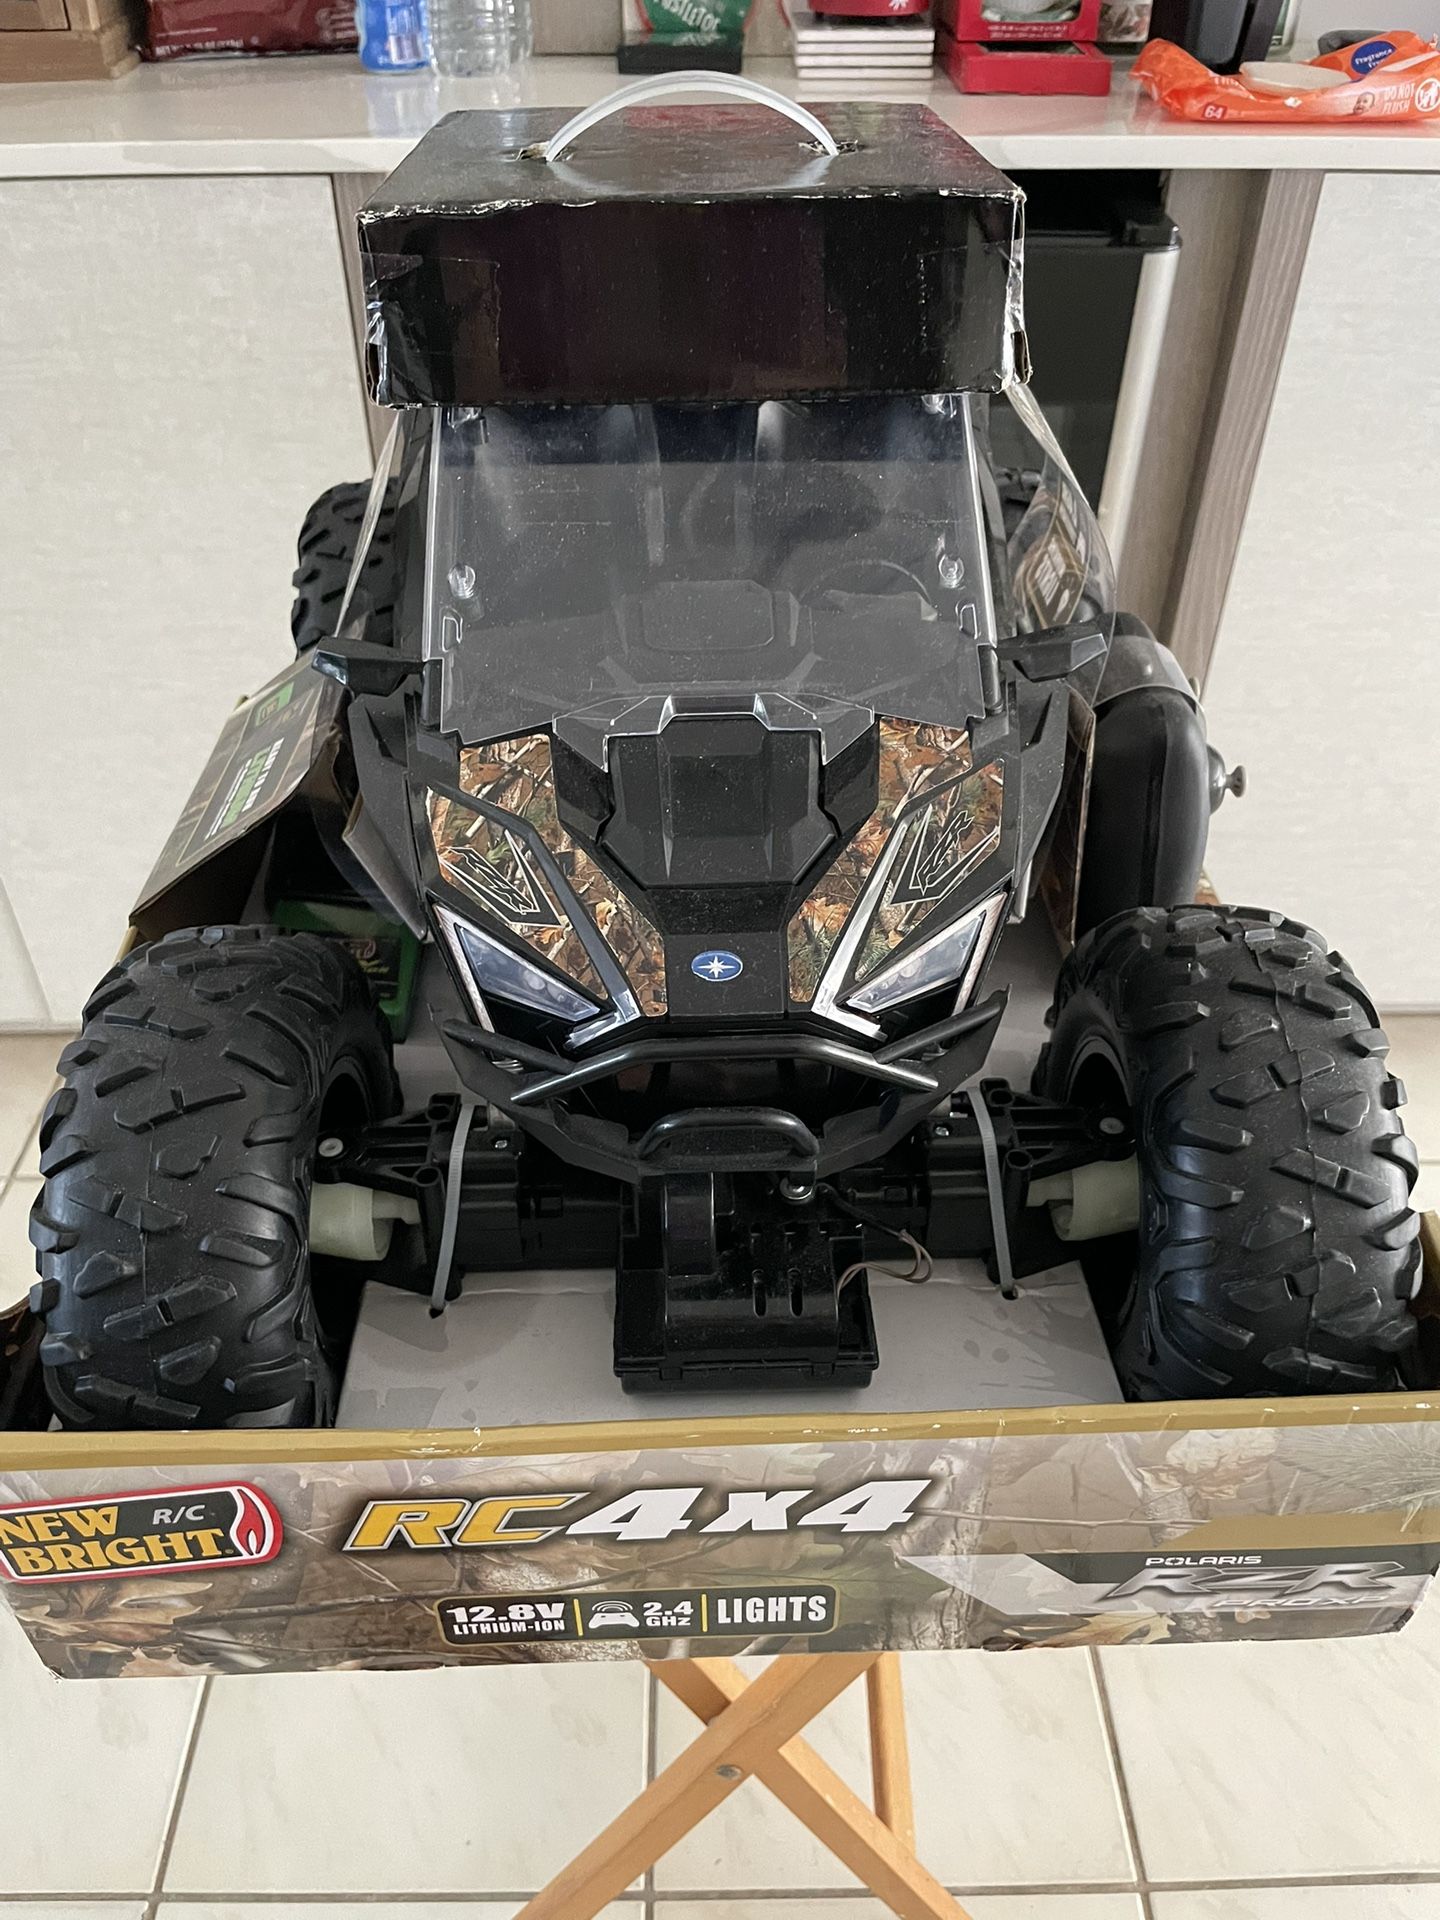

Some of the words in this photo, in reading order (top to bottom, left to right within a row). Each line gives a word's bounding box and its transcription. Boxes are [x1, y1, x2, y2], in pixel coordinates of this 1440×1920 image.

[1355, 49, 1393, 65] Fragrance
[1383, 85, 1398, 101] DO
[1398, 82, 1416, 99] NOT
[1204, 105, 1224, 119] 64
[1382, 99, 1411, 114] FLUSH
[152, 1504, 206, 1526] R/C
[343, 1492, 590, 1551] RC
[566, 1479, 932, 1542] 4x4
[0, 1506, 119, 1546] NEW
[7, 1528, 225, 1574] BRIGHT
[1145, 1555, 1262, 1567] POLARIS
[1104, 1561, 1405, 1600] RZR
[446, 1601, 566, 1624] 12.8V
[643, 1600, 694, 1617] 2.4
[717, 1595, 828, 1625] LIGHTS
[453, 1618, 566, 1636] LITHIUM-ION
